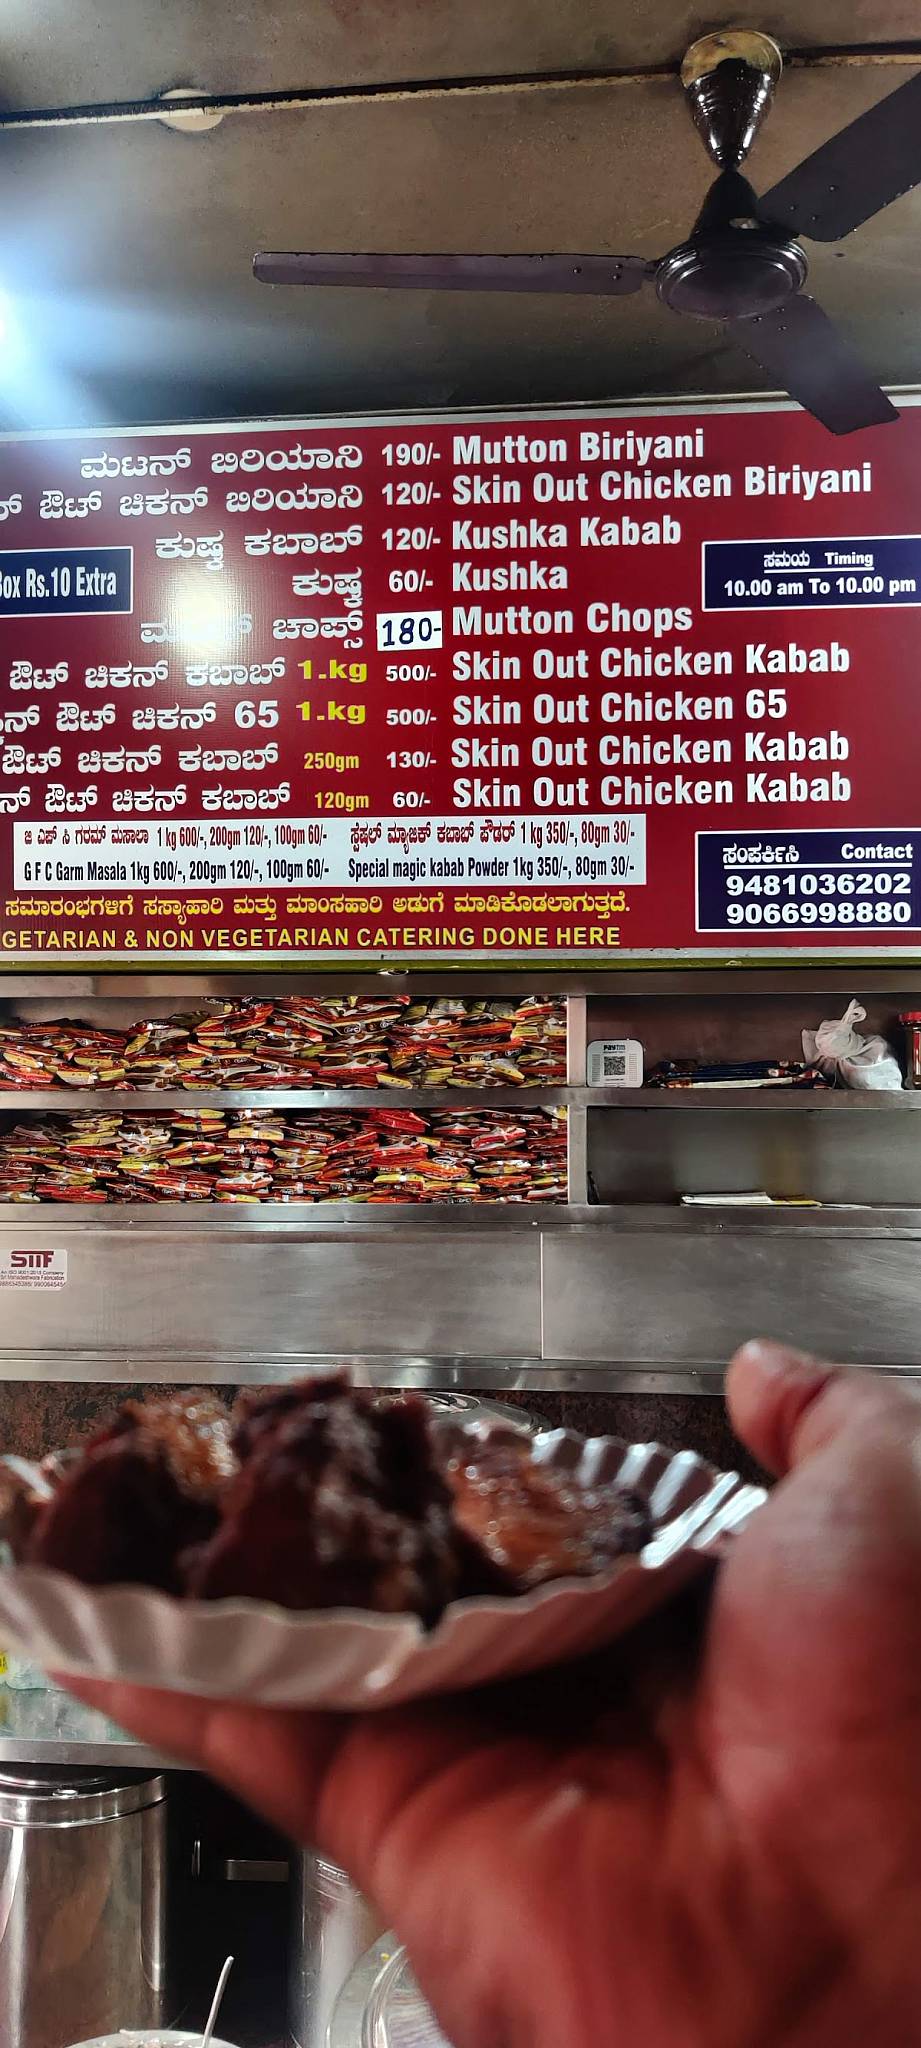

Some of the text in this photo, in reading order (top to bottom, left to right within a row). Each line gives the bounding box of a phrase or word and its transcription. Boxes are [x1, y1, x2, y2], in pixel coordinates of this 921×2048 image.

[80, 443, 363, 479] ಮಟನ್ ಬಿರಿಯಾನಿ
[381, 428, 703, 466] 190/- Mutton Biriyani
[381, 462, 872, 505] 120/- Skin Out Chicken Biriyani
[39, 490, 102, 519] ಔಟ್
[119, 487, 208, 516] ಚಿಕನ್
[226, 482, 363, 512] ಬಿರಿಯಾನಿ
[244, 525, 363, 556] ಕಬಾಬ್
[381, 515, 681, 550] 120/- Kushka Kabab
[763, 550, 810, 568] ಸಮಯ
[824, 552, 874, 568] Timing
[0, 566, 116, 599] ox Rs.10 Extra
[389, 560, 568, 593] 60/- Kushka
[724, 576, 916, 597] 10.00 am To 10.00 pm
[273, 610, 363, 649] ಚಾಪ್ಸ್
[452, 602, 693, 638] Mutton Chops
[9, 657, 285, 690] ಔಟ್ ಚಿಕನ್ ಕಬಾಬ್
[297, 642, 850, 683] 1.kg 500/- Skin Out Chicken Kabab
[56, 702, 116, 731] ಔಟ್
[132, 702, 216, 730] ಚಿಕನ್
[234, 700, 279, 729] 65
[296, 688, 787, 725] 1.kg 500/- Skin Out Chicken 65
[2, 742, 278, 774] ಔಟ್ ಚಿಕನ್ ಕಬಾಬ್
[304, 731, 849, 772] 250gm 130/- Skin Out Chicken Kabab
[45, 784, 98, 812] ಔಟ್
[112, 784, 187, 812] ಚಿಕನ್
[202, 782, 290, 811] ಕಬಾಬ್
[315, 771, 851, 812] 120gm 60/- Skin Out Chicken Kabab
[157, 827, 162, 847] 1
[165, 826, 176, 851] kg
[179, 826, 207, 850] 600/-,
[210, 826, 241, 850] 200gm
[243, 825, 271, 848] 120/-,
[274, 825, 305, 848] 100gm
[307, 824, 327, 846] 60/-
[437, 821, 474, 844] ಕಬಾಬ್
[520, 822, 525, 844] 1
[530, 821, 542, 848] kg
[546, 821, 578, 847] 350/-,
[581, 821, 610, 848] 80gm
[613, 820, 635, 844] 30/-
[723, 842, 800, 864] ಸಂಪರ್ಕಿಸಿ
[841, 843, 913, 860] Contact
[24, 859, 330, 884] G F C Garm Masala 1kg 600/-, 200gm 120/-, 100gm 60/-
[349, 856, 634, 882] Special magic kabab Powder 1kg 350/-, 80gm 30/-
[726, 873, 911, 896] 9481036202
[5, 895, 134, 919] ಸಮಾರಂಭಗಳಿಗೆ
[144, 896, 223, 926] ಸಸ್ಯಾಹಾರಿ
[233, 894, 277, 921] ಮತ್ತು
[392, 891, 444, 913] ಅಡುಗೆ
[726, 902, 911, 924] 9066998880
[124, 930, 138, 948] &
[146, 929, 193, 948] NON
[201, 928, 348, 947] VEGETARIAN
[357, 928, 475, 946] CATERING
[483, 927, 548, 946] DONE
[557, 927, 620, 946] HERE
